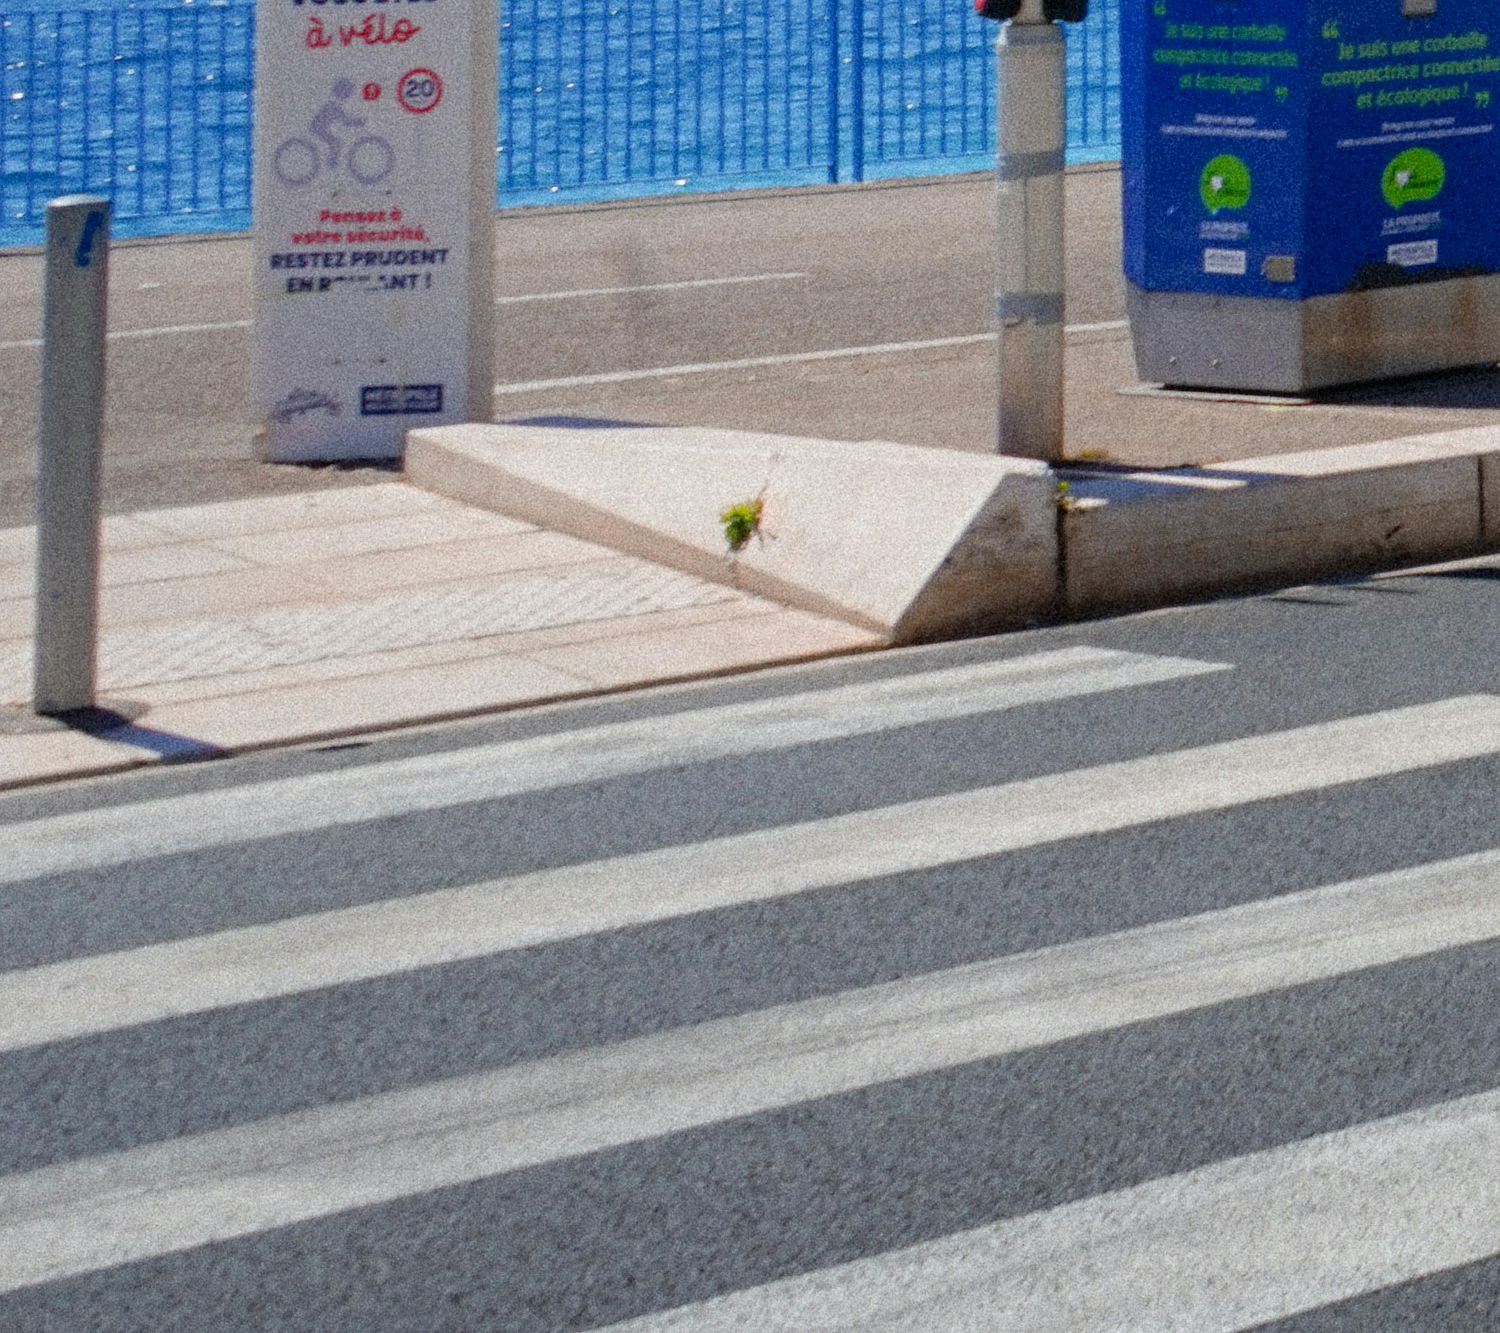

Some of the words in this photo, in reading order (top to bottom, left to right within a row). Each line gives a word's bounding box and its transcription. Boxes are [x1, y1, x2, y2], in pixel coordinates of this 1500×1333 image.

[306, 15, 333, 49] à
[340, 12, 421, 46] vélo
[405, 79, 435, 98] 20
[270, 251, 347, 269] RESTEZ
[350, 248, 450, 266] PRUDENT
